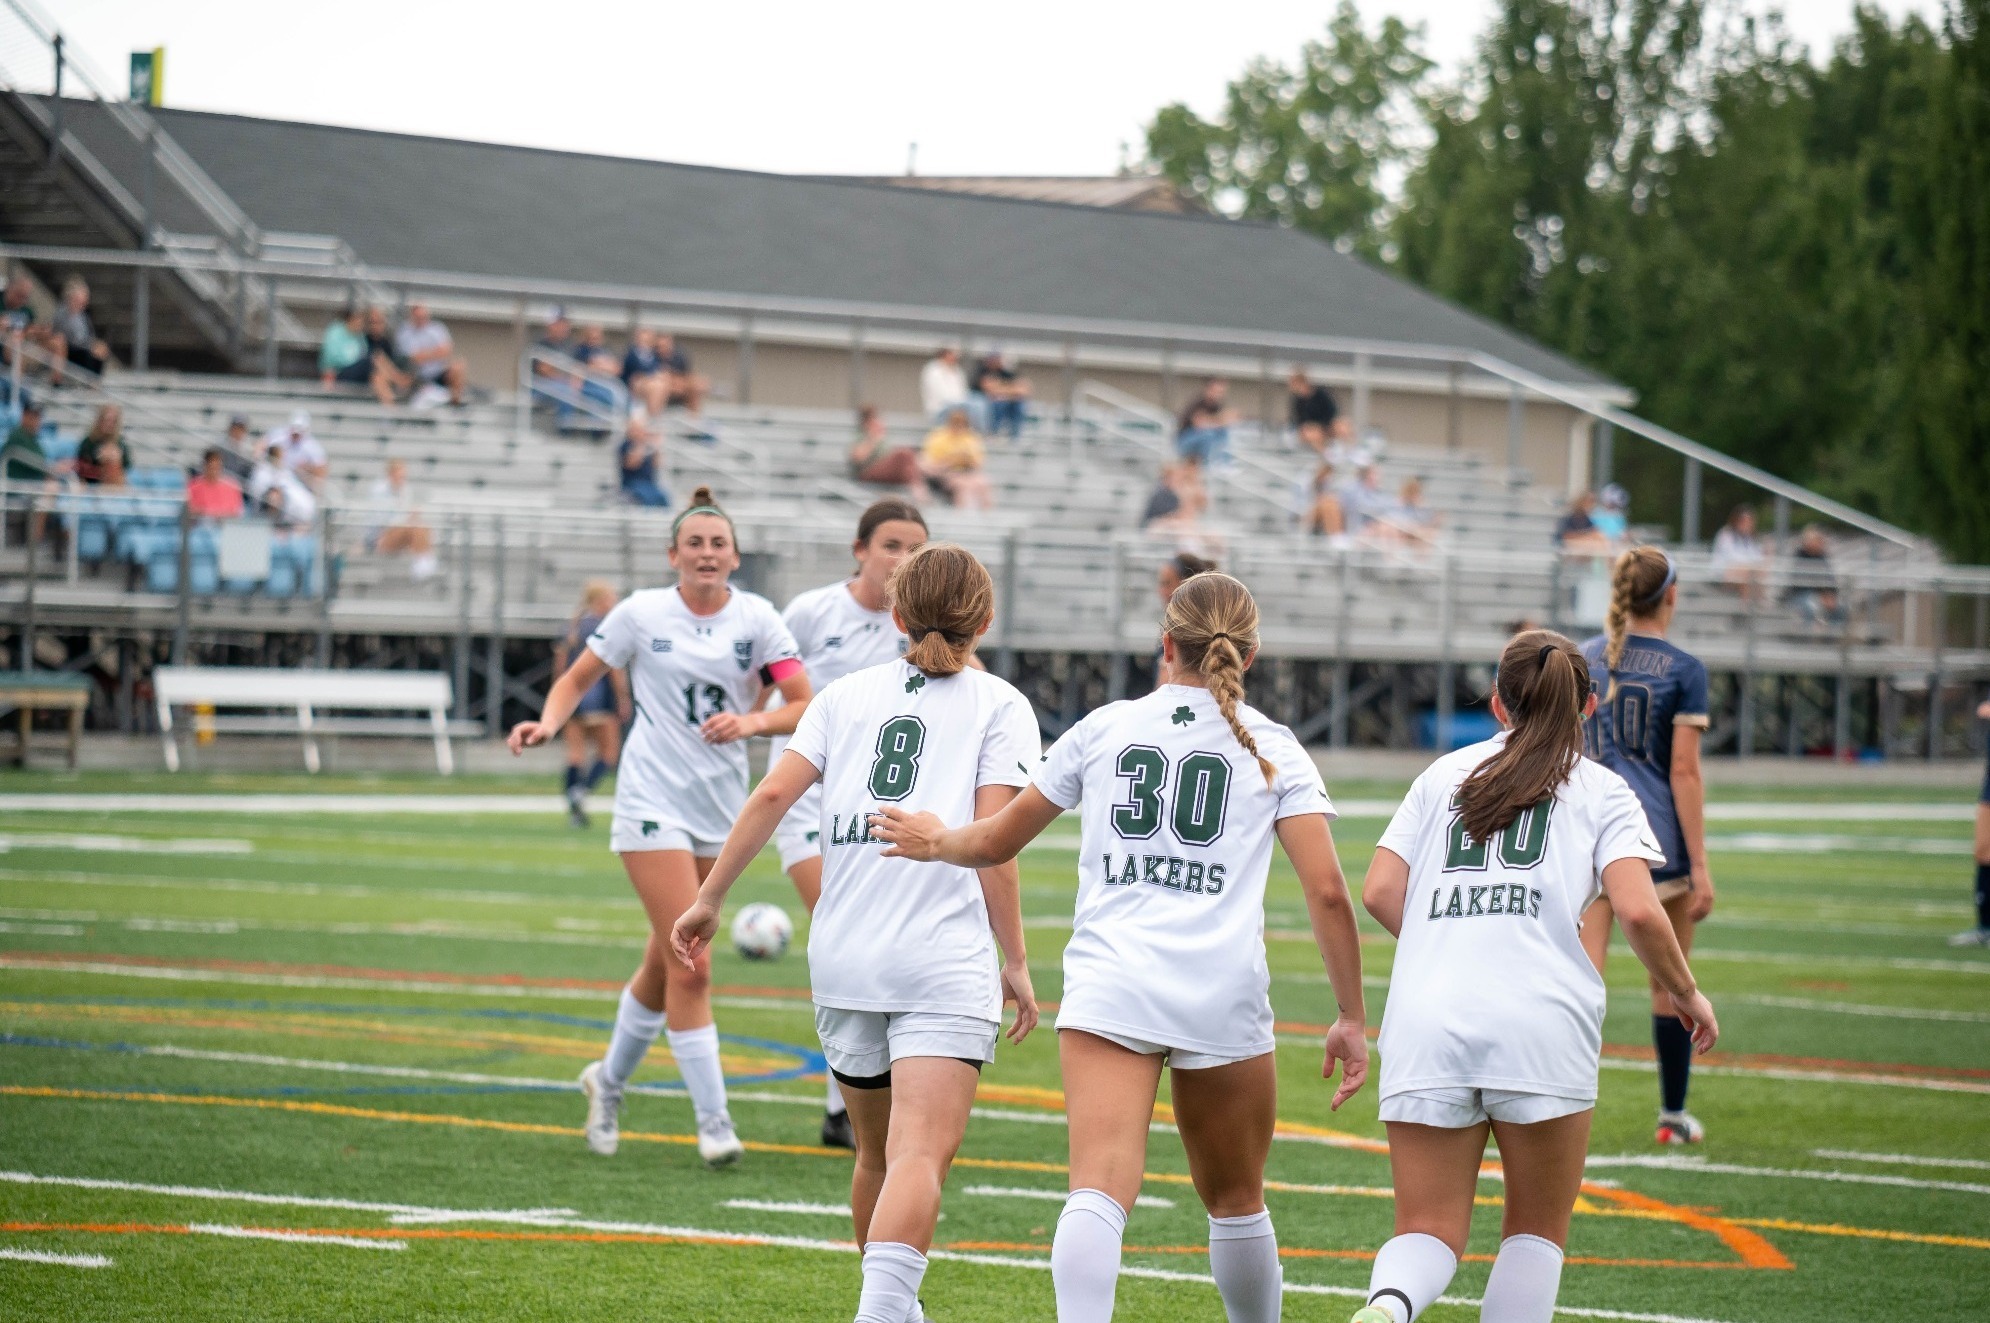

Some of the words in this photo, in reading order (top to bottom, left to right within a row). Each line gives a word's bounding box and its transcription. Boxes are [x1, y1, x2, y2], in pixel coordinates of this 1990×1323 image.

[683, 683, 725, 727] 13
[867, 714, 927, 802] 8
[1111, 743, 1233, 848] 30
[831, 812, 896, 847] LAK
[1442, 786, 1557, 874] 20
[1103, 853, 1227, 896] LAKERS
[1427, 882, 1542, 922] LAKERS
